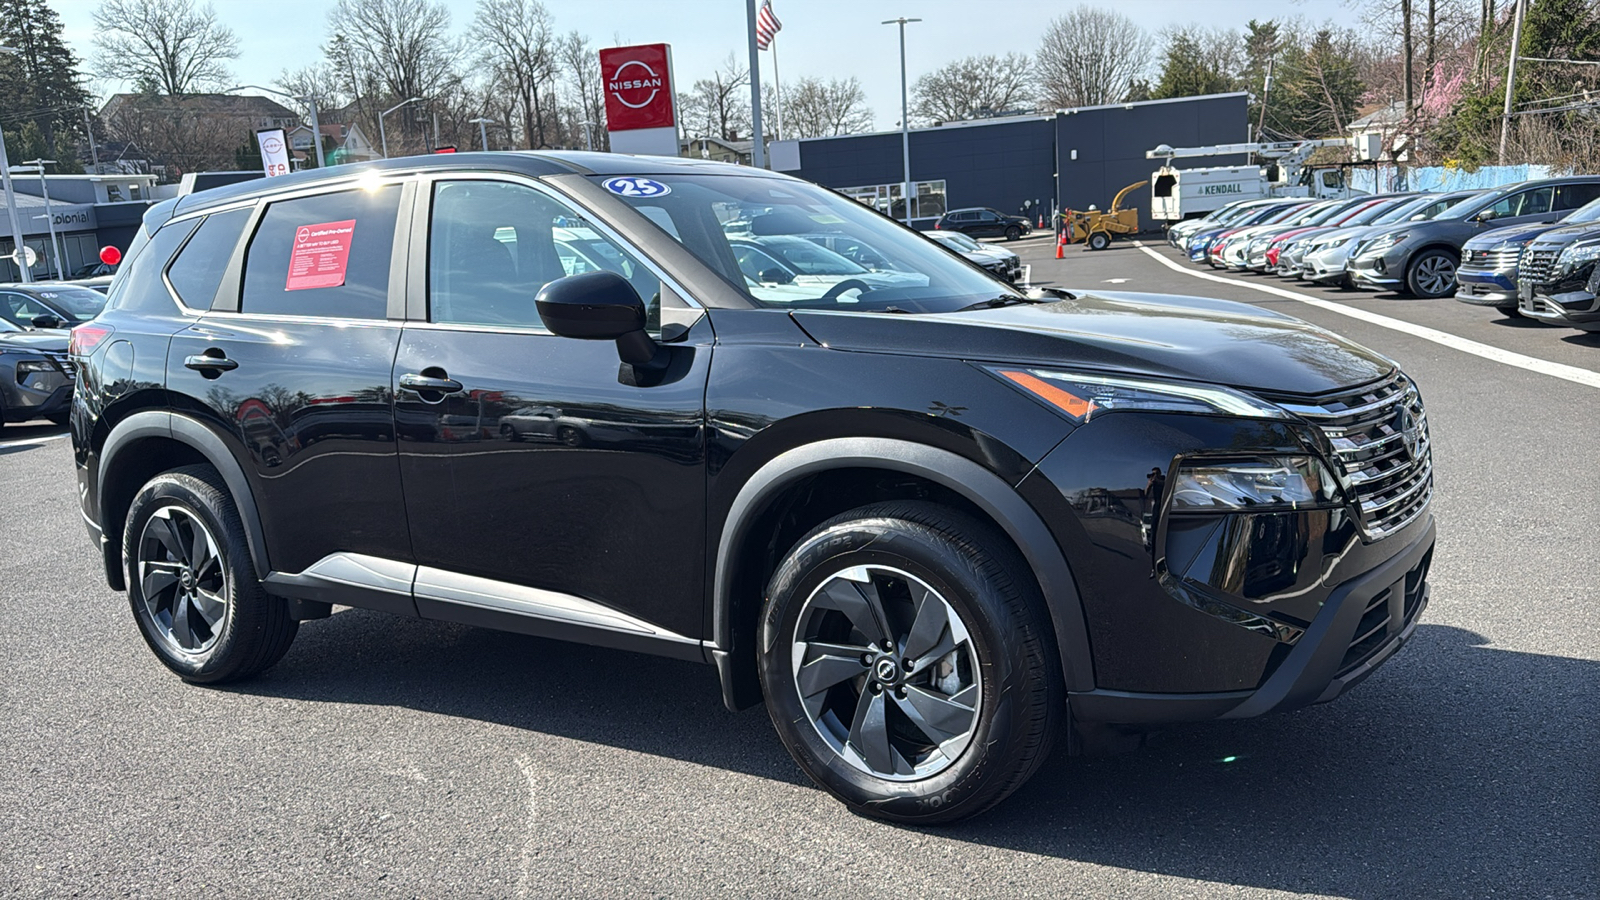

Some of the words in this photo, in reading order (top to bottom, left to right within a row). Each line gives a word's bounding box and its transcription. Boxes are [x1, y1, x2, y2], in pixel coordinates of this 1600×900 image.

[609, 78, 661, 91] NISSAN
[614, 179, 658, 196] 25
[1205, 184, 1242, 195] KENDALL
[311, 229, 329, 237] Certified
